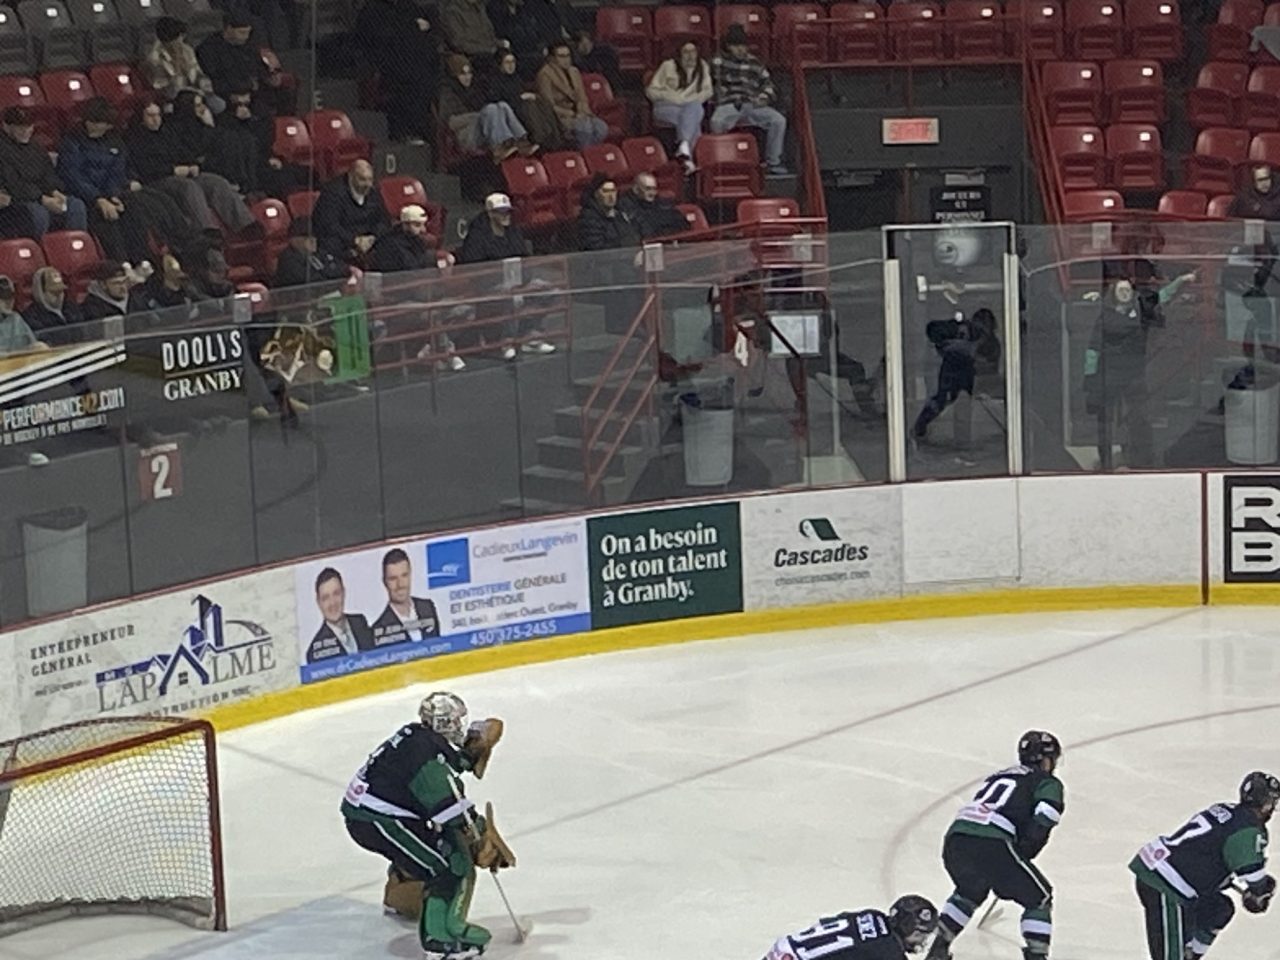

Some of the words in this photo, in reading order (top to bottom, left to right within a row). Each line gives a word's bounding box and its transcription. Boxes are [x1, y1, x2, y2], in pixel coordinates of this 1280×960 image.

[163, 367, 243, 400] GRANBY
[151, 454, 173, 499] 2
[472, 532, 579, 559] CadieuxLangevin
[601, 534, 631, 556] On
[634, 535, 647, 552] a
[649, 522, 718, 550] besoin
[602, 558, 628, 582] de
[630, 555, 664, 578] ton
[668, 548, 728, 573] talent
[774, 543, 870, 567] Cascades
[449, 581, 512, 601] DENTISTERIE
[602, 584, 615, 607] à
[617, 577, 695, 605] Granby.
[30, 624, 136, 660] ENTREPRENEUR
[470, 631, 494, 646] 450
[31, 652, 92, 677] GÉNÉRAL
